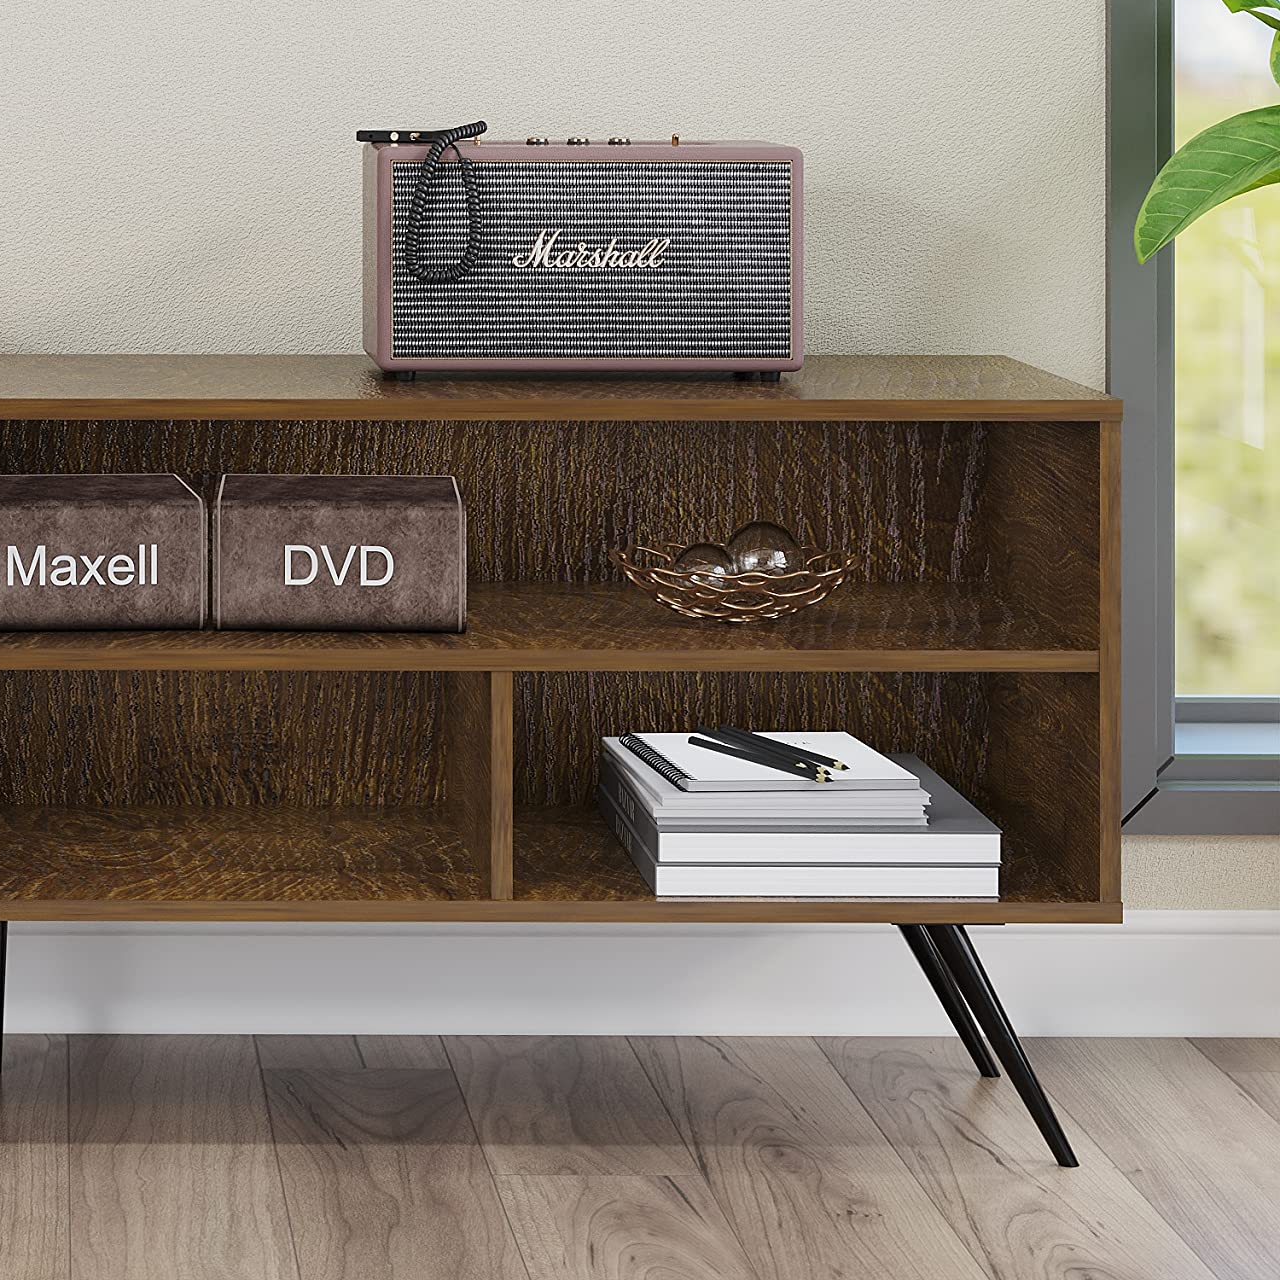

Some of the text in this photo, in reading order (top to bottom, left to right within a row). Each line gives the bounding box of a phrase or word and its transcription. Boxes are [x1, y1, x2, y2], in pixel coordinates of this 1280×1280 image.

[513, 228, 670, 268] Marshall
[6, 544, 158, 586] Maxell
[283, 544, 395, 586] DVD
